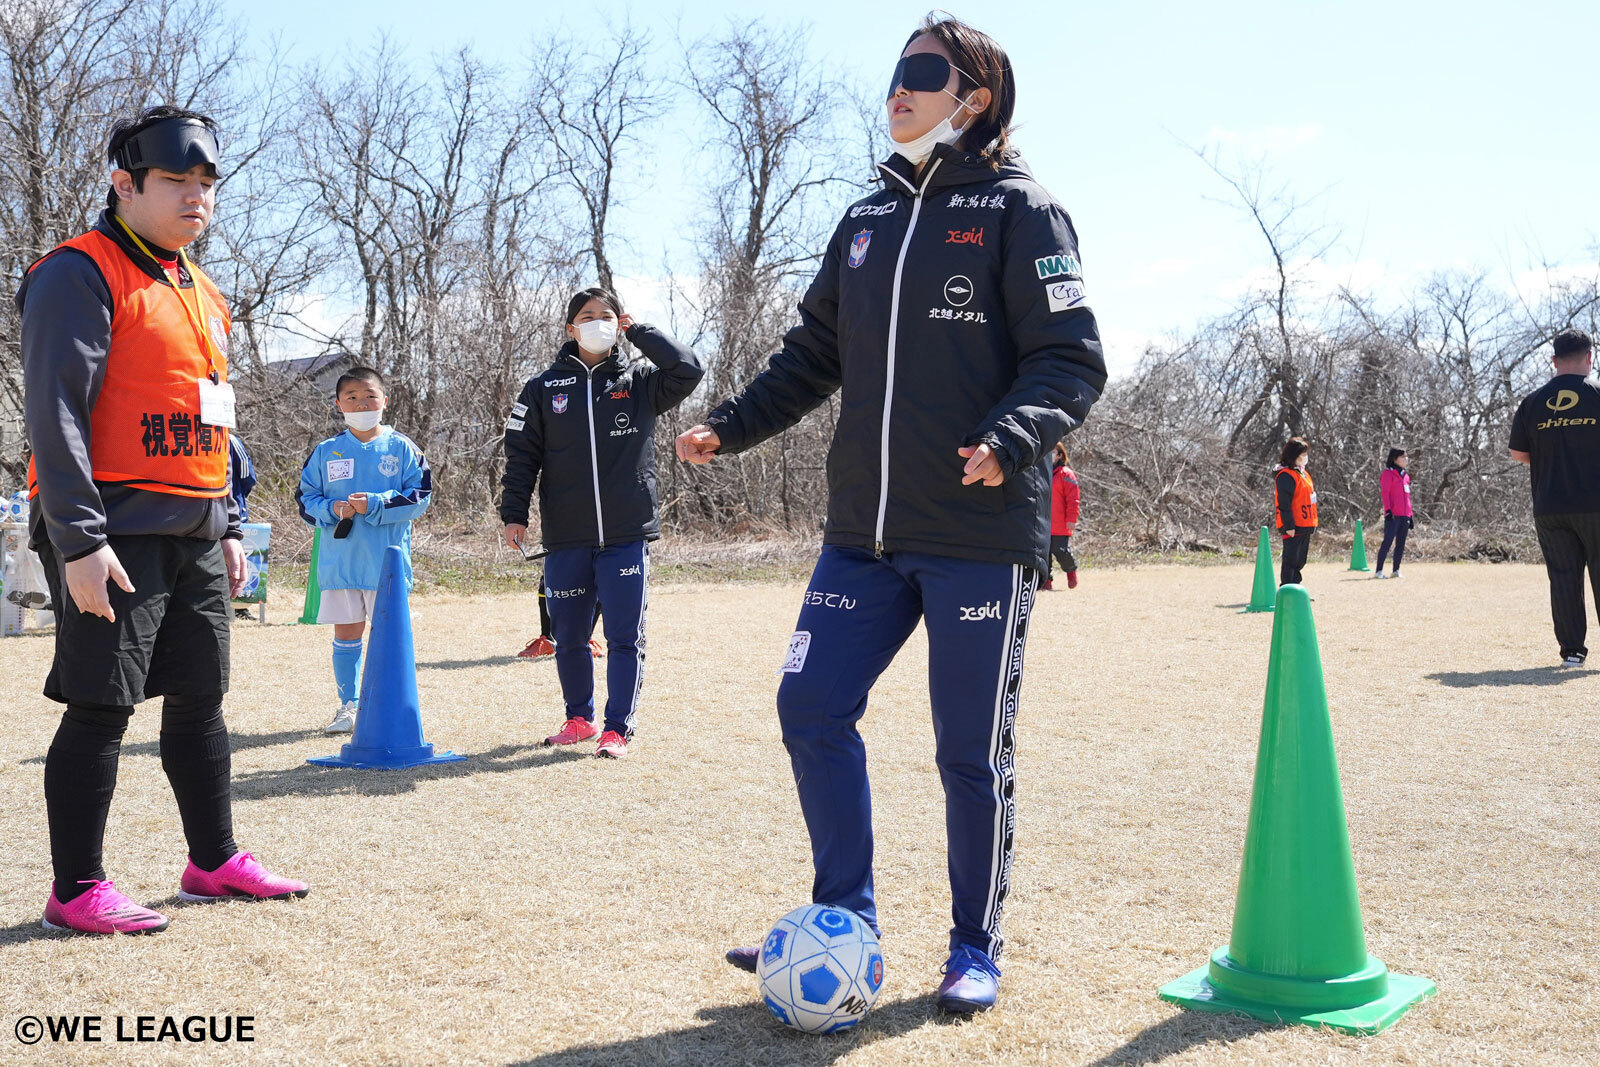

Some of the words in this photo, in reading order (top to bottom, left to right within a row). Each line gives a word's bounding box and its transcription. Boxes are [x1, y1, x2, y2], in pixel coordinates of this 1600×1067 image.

[1052, 284, 1083, 300] Cra
[929, 308, 987, 323] 北越メタル
[1018, 581, 1032, 625] XGIRL
[1010, 637, 1024, 681] XGIRL
[1003, 692, 1016, 736] XGIRL
[1000, 745, 1015, 787] XGIRL
[1006, 796, 1015, 839] XGIRL
